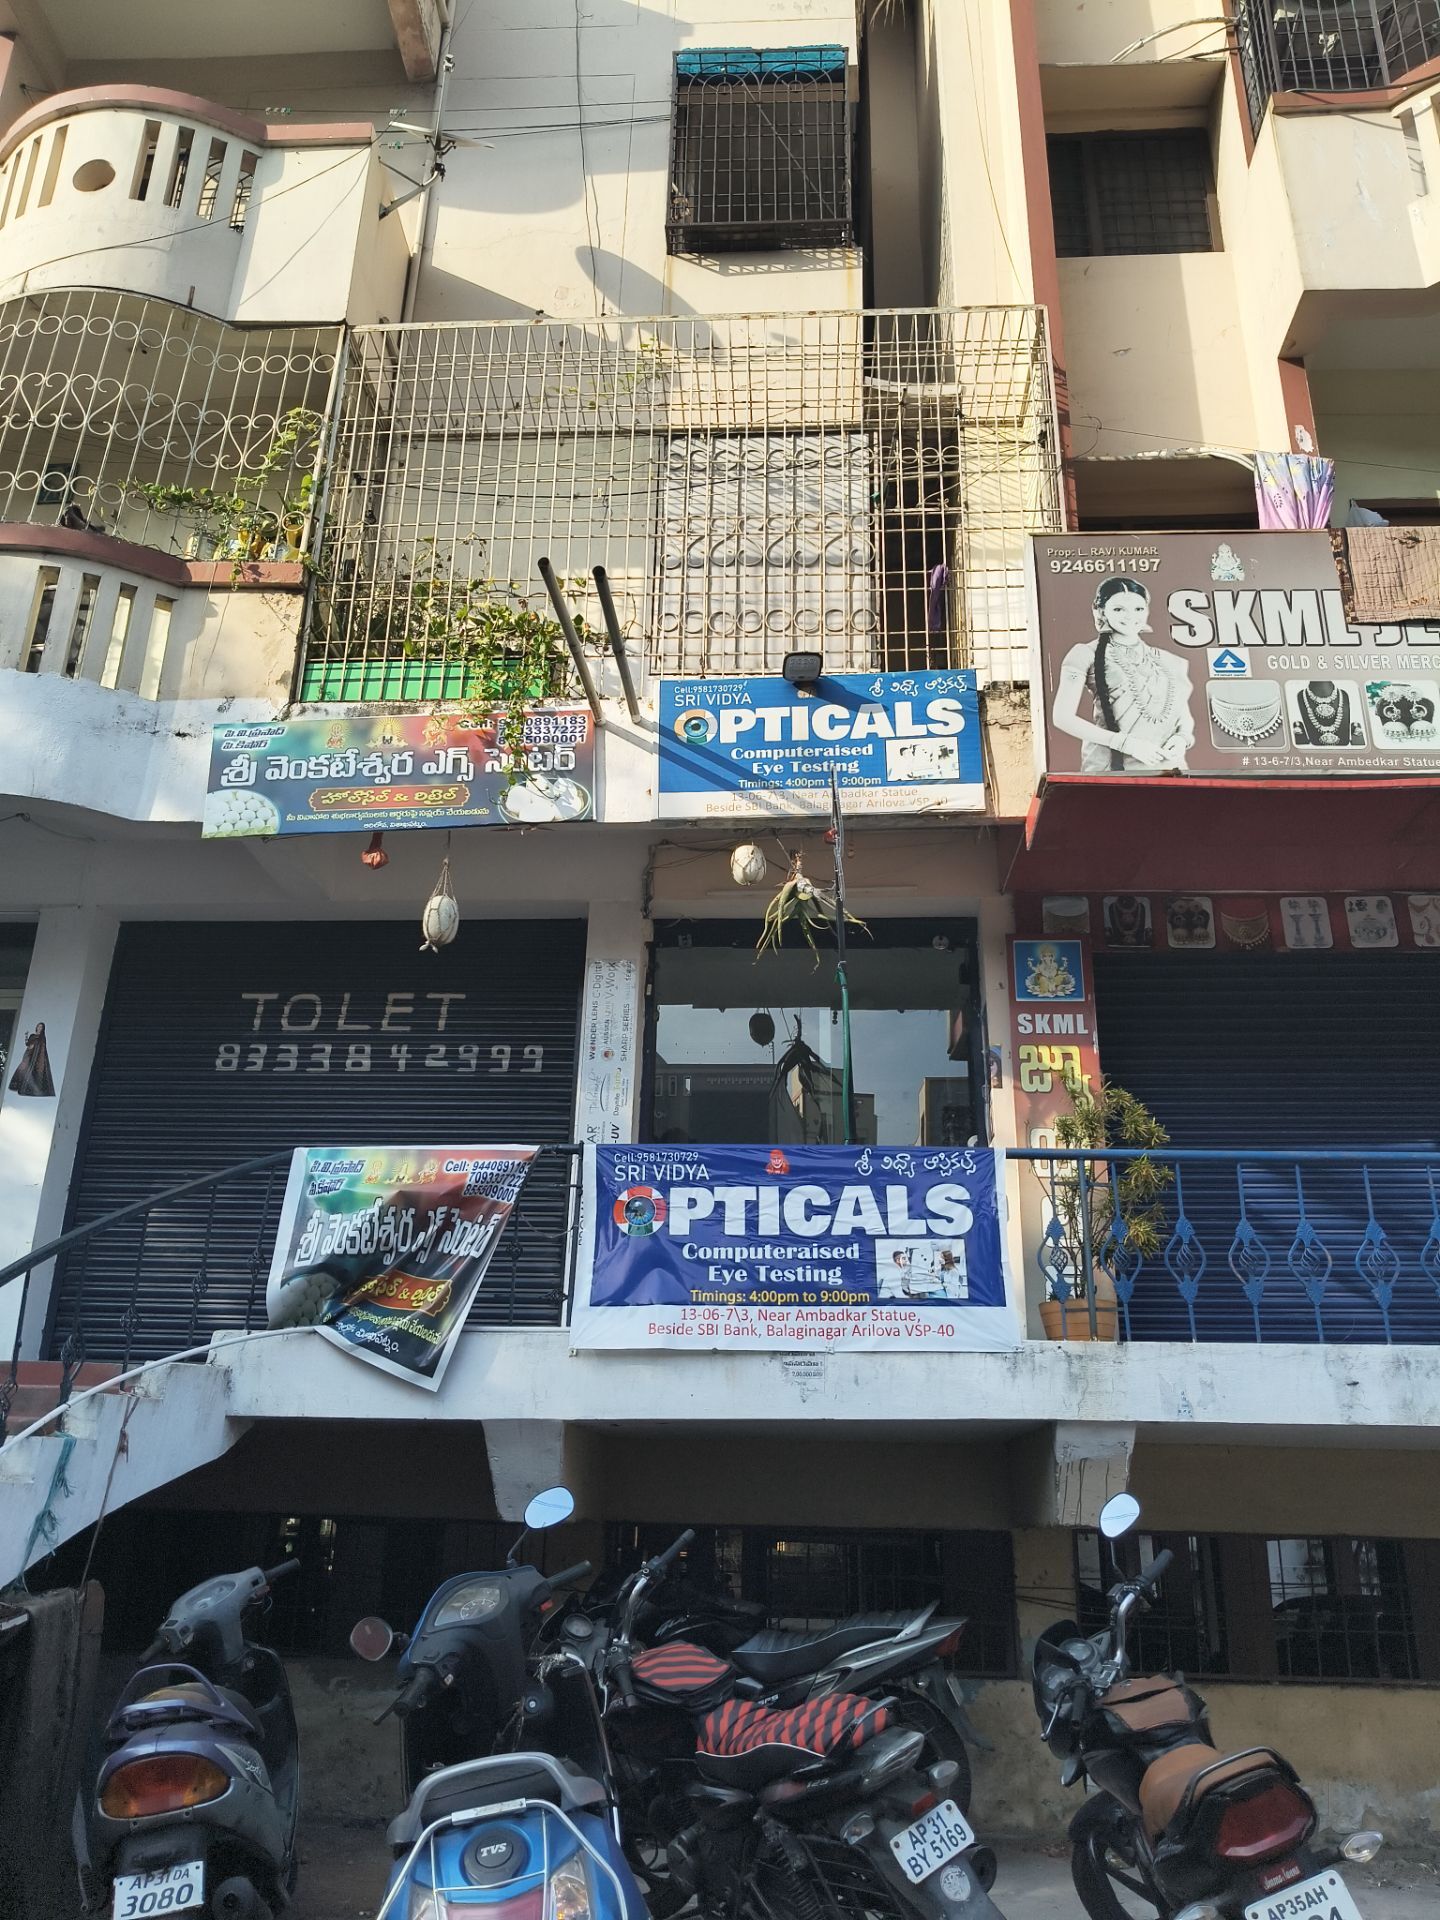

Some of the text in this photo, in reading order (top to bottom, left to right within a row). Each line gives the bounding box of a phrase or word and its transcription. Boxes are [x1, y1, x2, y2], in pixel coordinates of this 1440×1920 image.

[1047, 547, 1075, 557] Prop:
[1090, 546, 1116, 556] RAVI
[1119, 546, 1158, 556] KUMAR
[1050, 558, 1161, 573] 9246611197
[1167, 588, 1360, 647] SKML
[1267, 655, 1312, 670] GOLD
[1316, 655, 1328, 670] &
[1334, 655, 1392, 670] SILVER
[869, 677, 884, 697] శ్రీ
[674, 692, 752, 707] SRI VIDYA
[731, 744, 874, 762] Computeraised
[221, 752, 258, 788] శ్రీ
[265, 746, 414, 786] వెంకటేశ్వర
[752, 760, 859, 777] Eye Testing
[1242, 757, 1250, 767] #
[1338, 757, 1399, 767] Ambedkar
[738, 778, 783, 791] Timings:
[785, 777, 825, 789] 4:00pm
[842, 775, 882, 788] 9:00pm
[392, 793, 410, 802] &
[792, 789, 819, 800] Near
[822, 788, 879, 799] Abadkar
[706, 802, 742, 813] Beside
[744, 801, 764, 812] SBI
[1017, 1013, 1088, 1035] SKML
[445, 1160, 469, 1173] Cell:
[855, 1148, 873, 1176] శ్రీ
[614, 1164, 710, 1182] SRI VIDYA
[294, 1209, 323, 1268] శ్రీ
[682, 1243, 859, 1264] Computeraised
[708, 1265, 842, 1285] Eye Testing
[398, 1288, 409, 1299] &
[690, 1290, 870, 1305] Timings: 4:00pm to 9:00pm
[757, 1309, 792, 1322] Near
[795, 1308, 867, 1322] Ambadkar
[871, 1309, 921, 1324] Statue,
[648, 1321, 955, 1339] Beside SBI Bank, Balaginagar Arilova VSP-40
[908, 1811, 948, 1851] AP 31
[480, 1842, 507, 1857] TVS
[906, 1847, 931, 1878] BY
[930, 1823, 967, 1859] 5169
[121, 1882, 194, 1918] 3080
[1266, 1885, 1329, 1920] AP35AH
